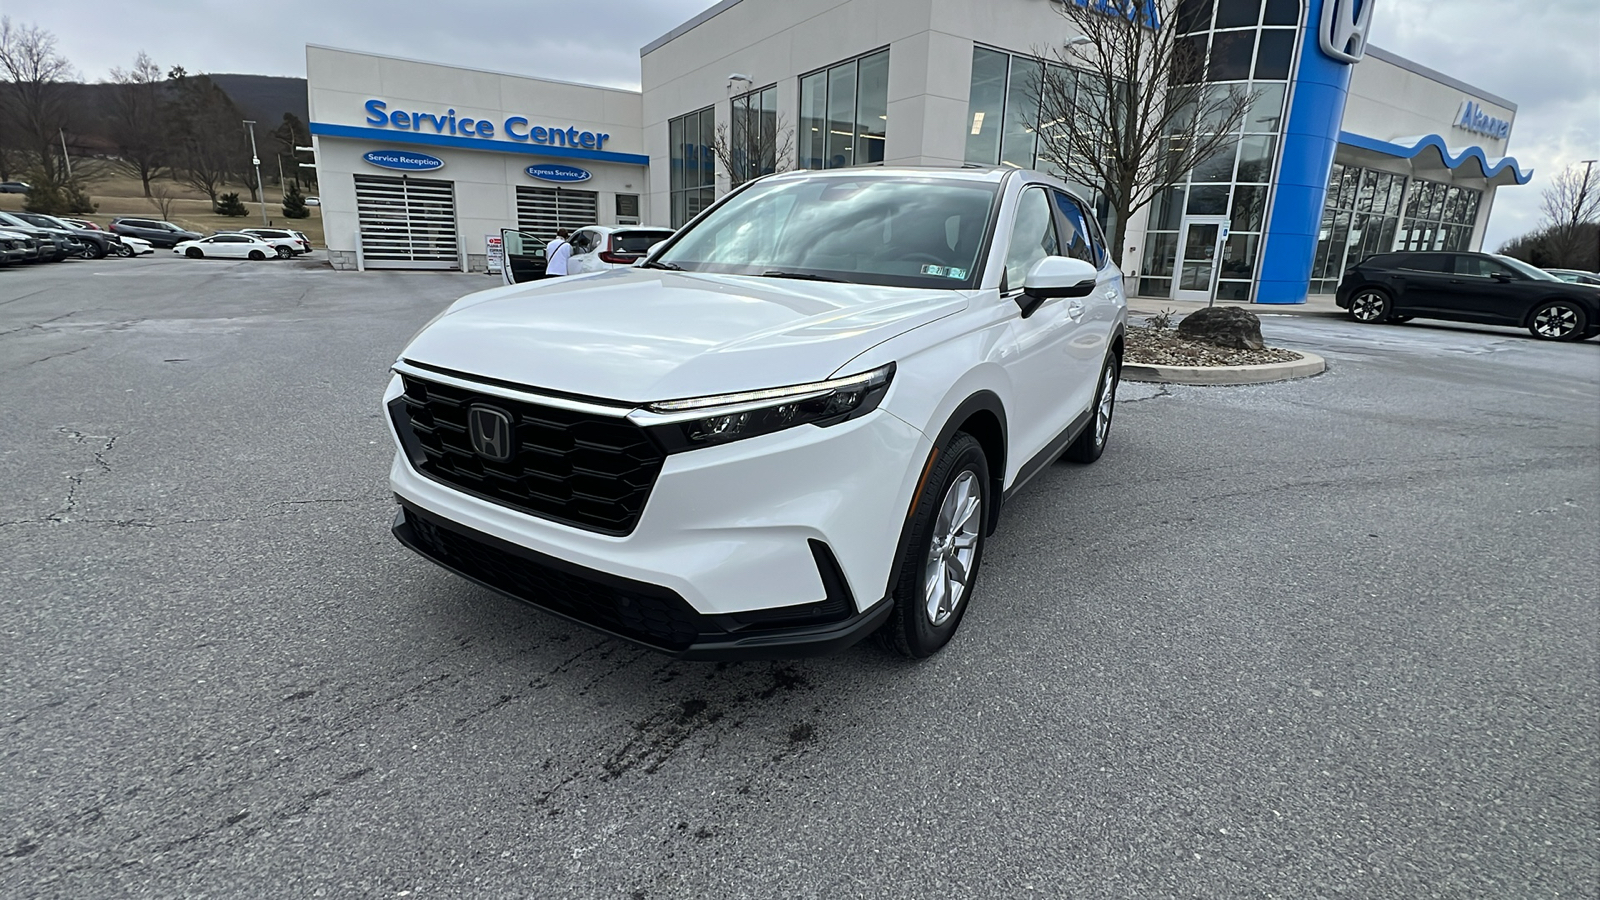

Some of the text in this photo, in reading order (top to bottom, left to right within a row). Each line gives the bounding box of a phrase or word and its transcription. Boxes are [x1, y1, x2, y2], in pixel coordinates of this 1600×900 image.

[365, 99, 610, 149] Service Center
[368, 153, 439, 166] Service Reception
[529, 167, 554, 176] Express
